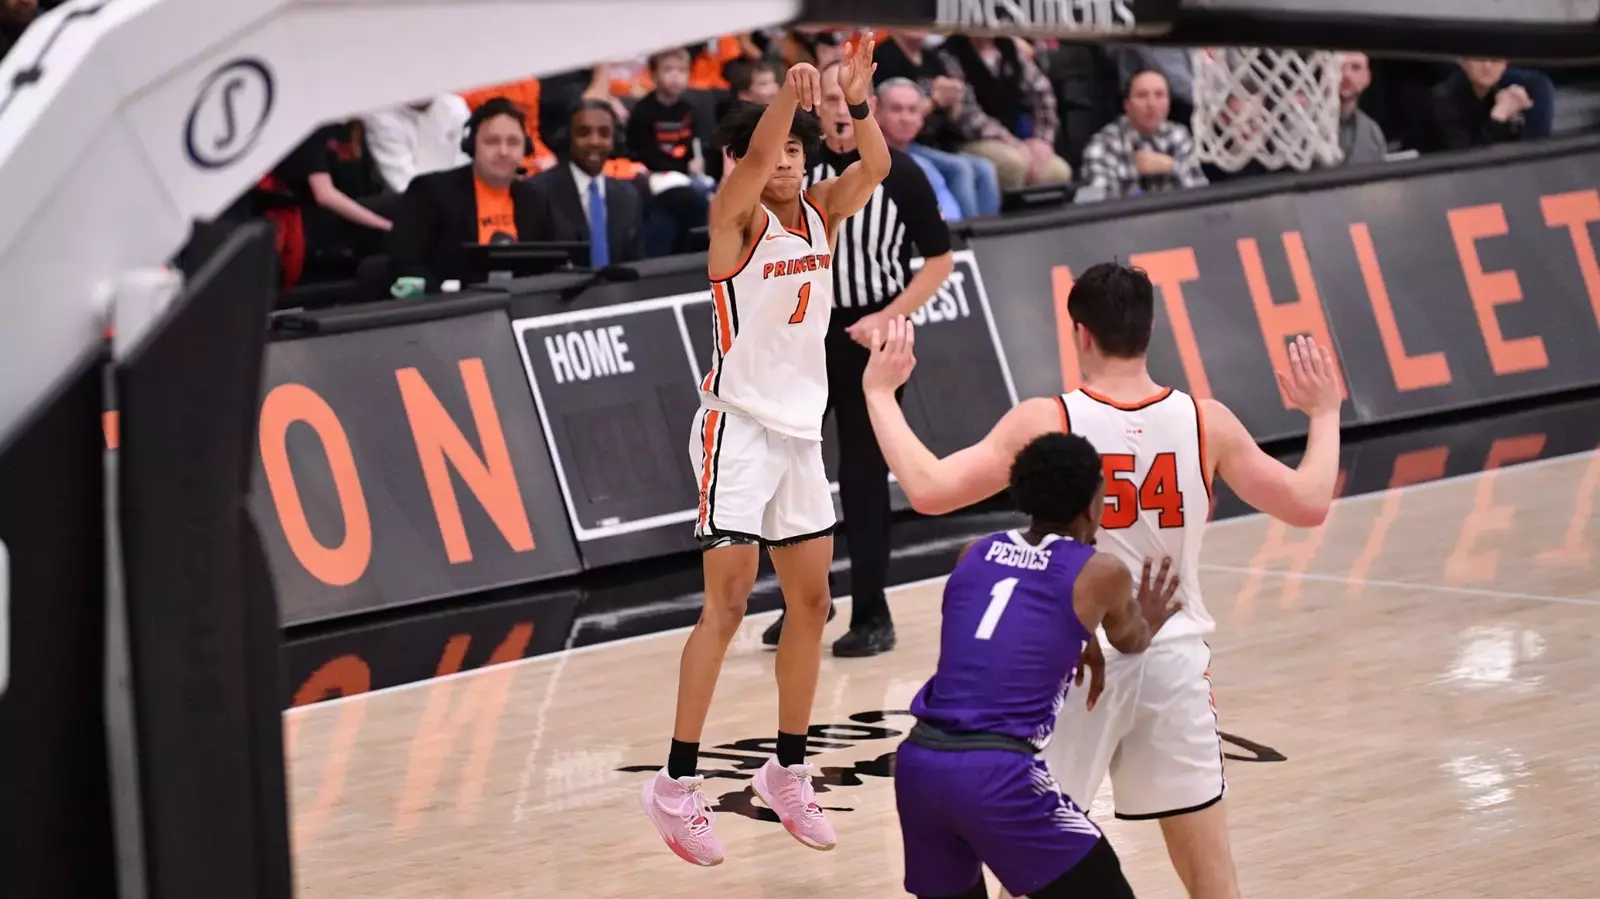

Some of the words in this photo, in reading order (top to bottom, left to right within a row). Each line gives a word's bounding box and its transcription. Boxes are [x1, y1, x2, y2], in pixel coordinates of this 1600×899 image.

[788, 281, 811, 324] 1
[1052, 189, 1600, 409] THLET
[544, 325, 635, 384] HOME
[1099, 452, 1184, 529] 54
[985, 540, 1052, 571] PEGUES
[974, 577, 1019, 640] 1
